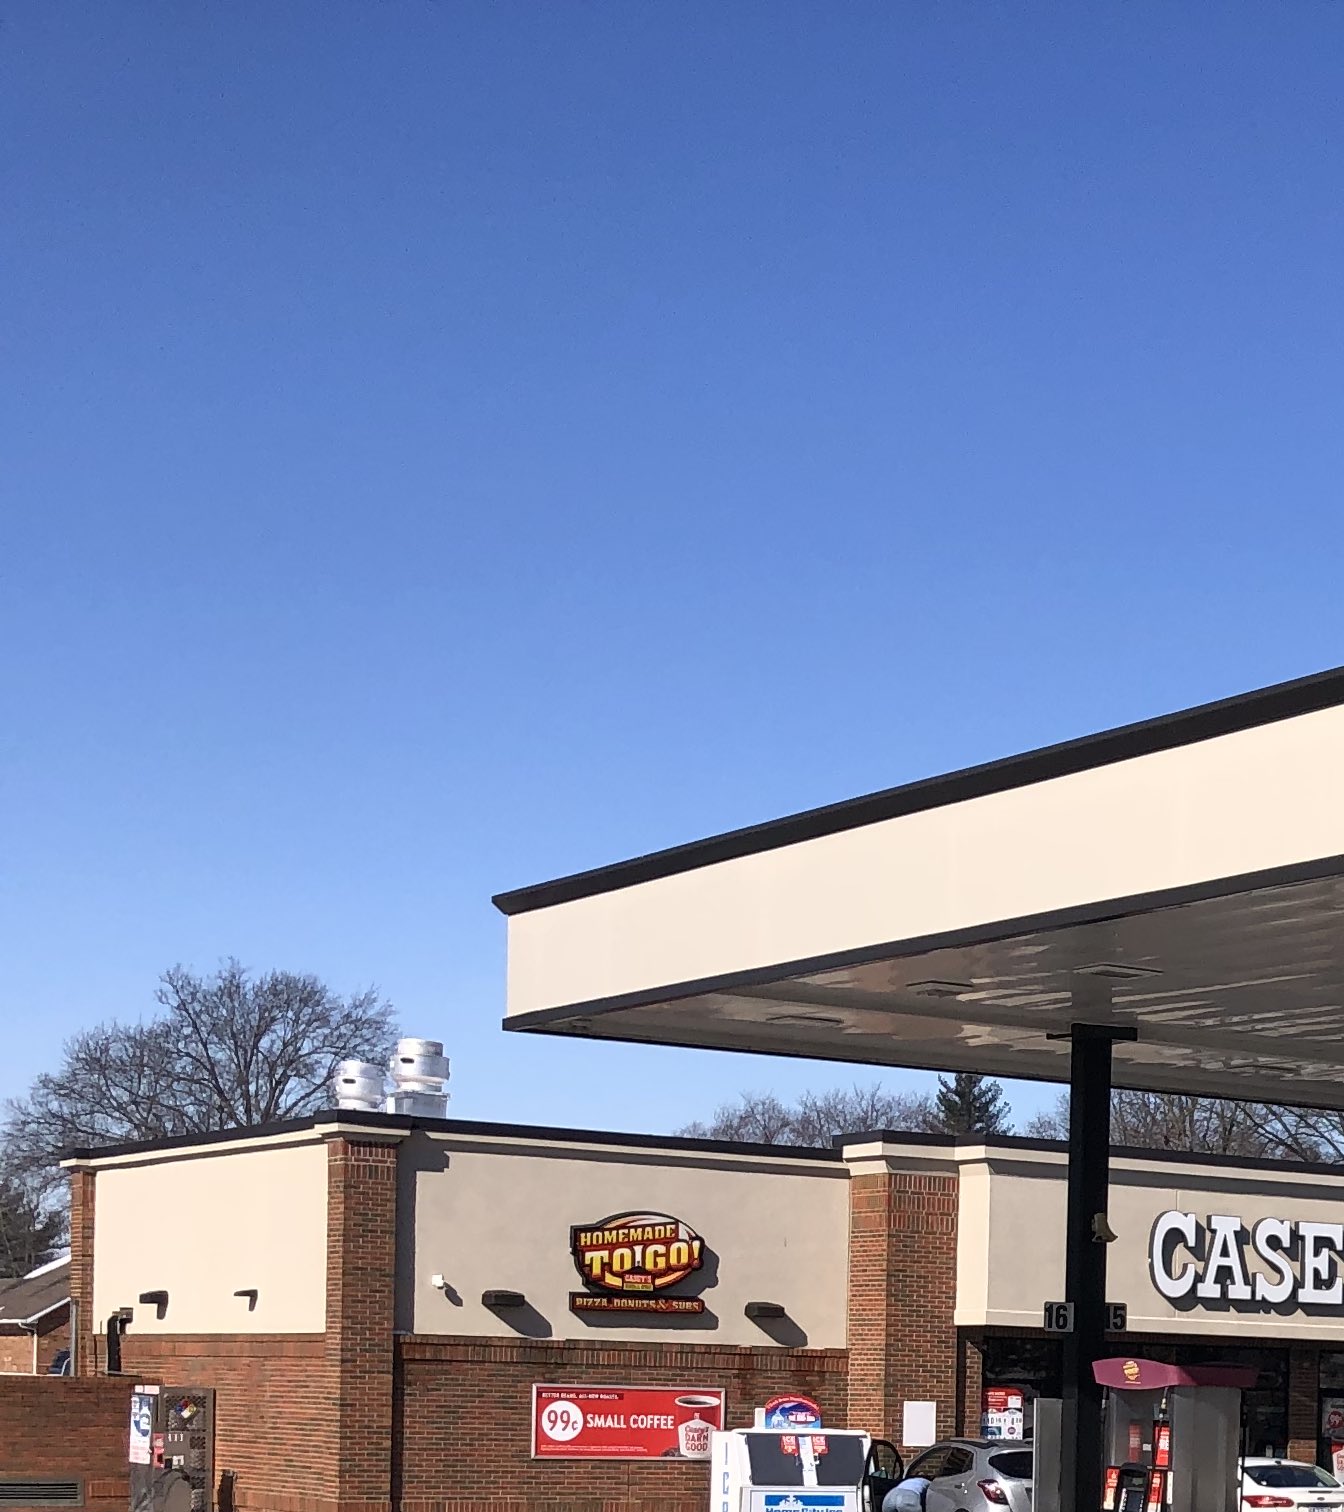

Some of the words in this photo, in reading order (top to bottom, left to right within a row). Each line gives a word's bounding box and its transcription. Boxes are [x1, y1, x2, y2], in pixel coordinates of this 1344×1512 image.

[580, 1224, 676, 1246] HOMEMADE
[584, 1247, 633, 1278] TO
[645, 1240, 700, 1271] GO!
[613, 1298, 656, 1308] DONUTS
[672, 1300, 699, 1310] SUBS
[1045, 1304, 1068, 1329] 16
[1106, 1304, 1126, 1330] 15
[586, 1413, 627, 1429] SMALL
[629, 1415, 675, 1430] COFFEE
[782, 1436, 796, 1445] ICE
[812, 1436, 826, 1445] ICE
